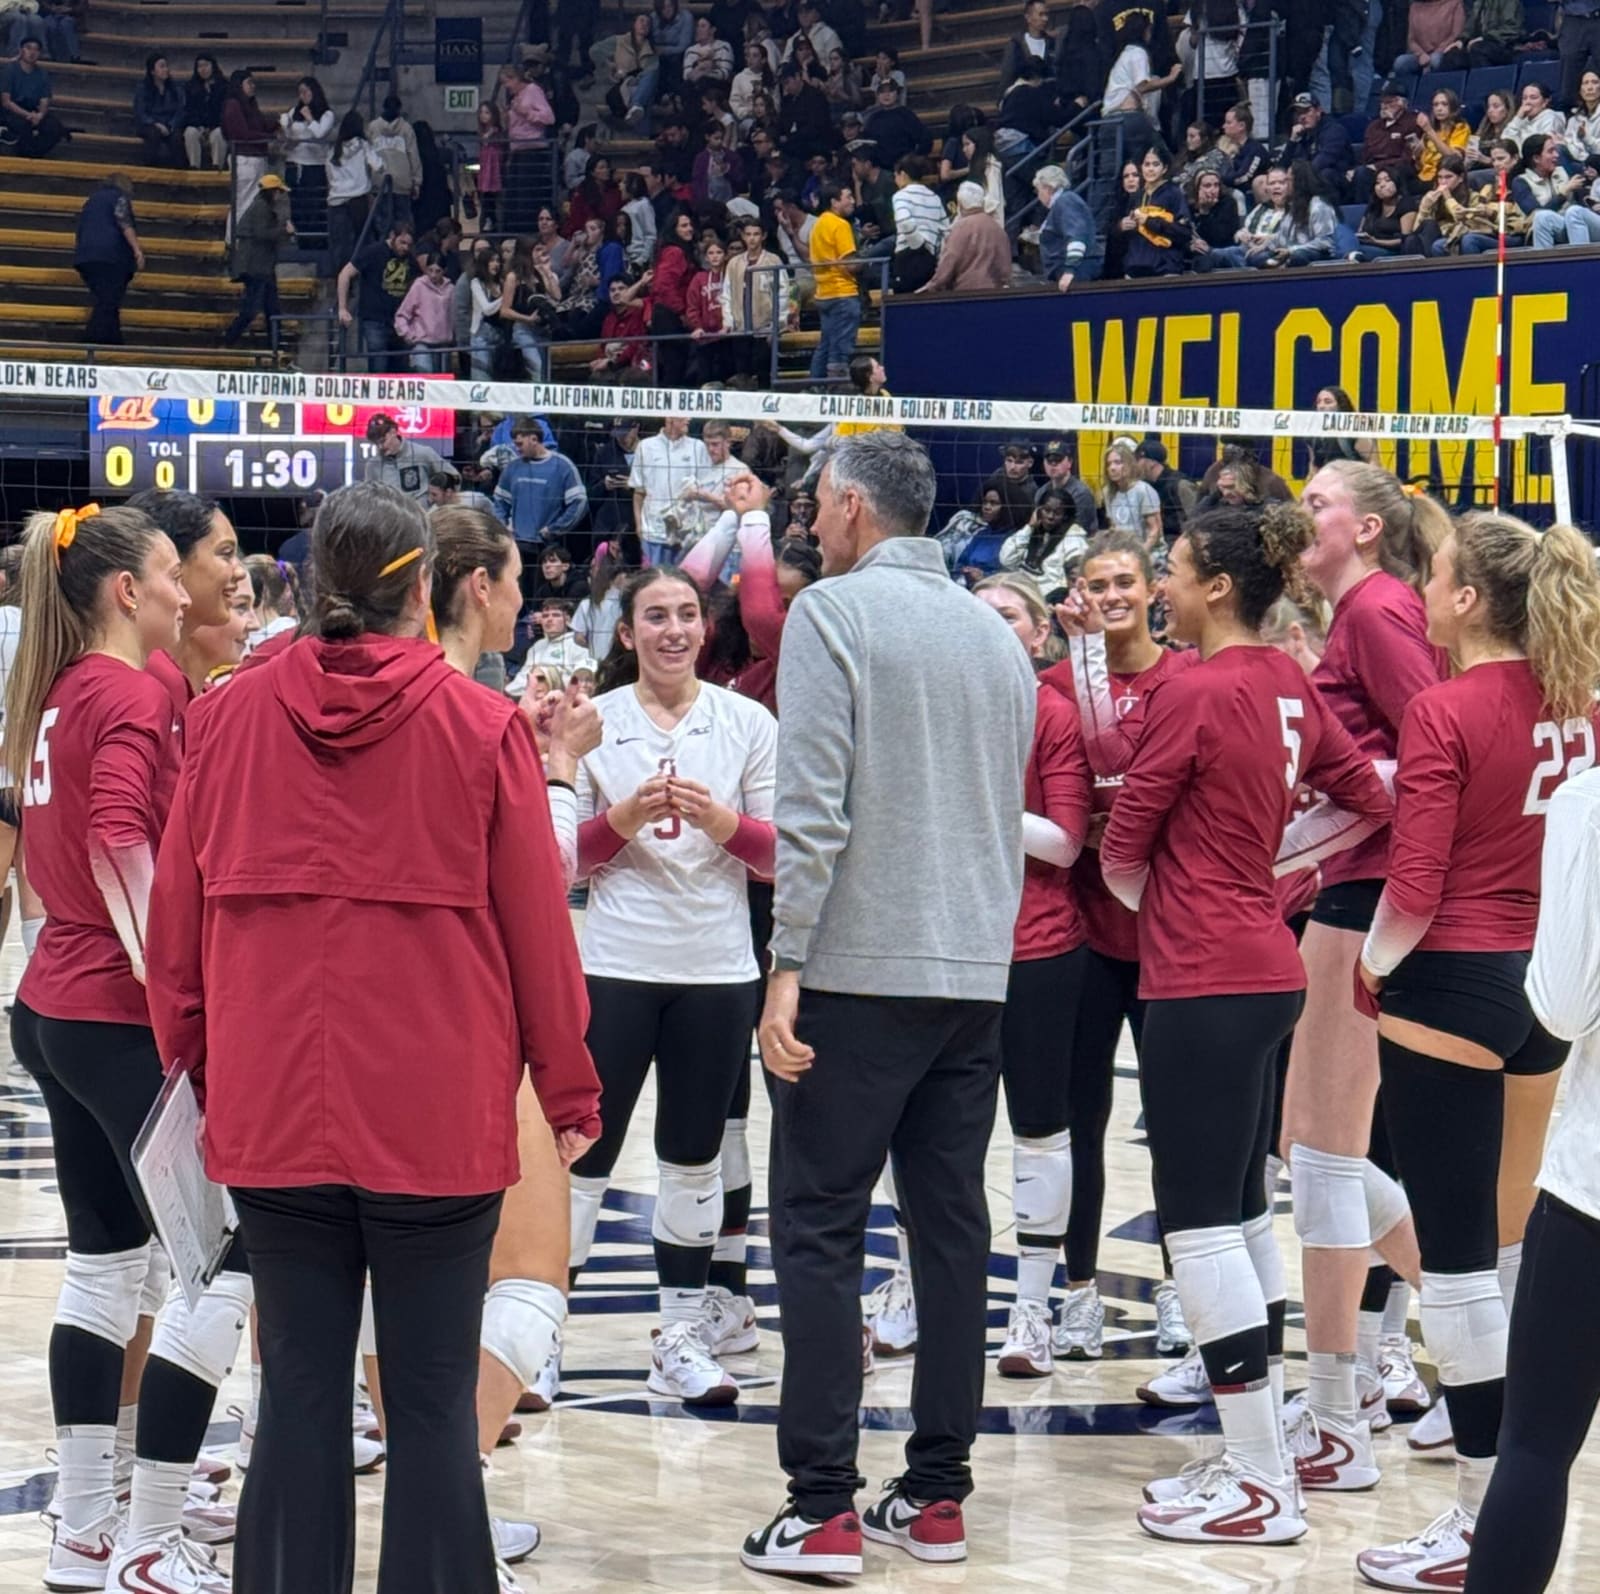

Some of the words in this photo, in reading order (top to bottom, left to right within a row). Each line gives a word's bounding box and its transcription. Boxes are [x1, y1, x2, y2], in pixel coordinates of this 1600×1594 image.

[440, 44, 479, 56] HAAS
[449, 90, 475, 108] EXIT
[0, 364, 36, 387] DEN
[45, 366, 98, 389] BEARS
[147, 370, 170, 391] Cal
[216, 373, 307, 397] CALIFORNIA
[314, 376, 371, 399] GOLDEN
[377, 379, 426, 401] BEARS
[470, 383, 491, 403] Cal
[533, 385, 615, 409] CALIFORNIA
[621, 389, 672, 410] GOLDEN
[678, 392, 723, 412] BEARS
[761, 395, 782, 413] Cal
[1071, 292, 1568, 505] WELCOME
[260, 402, 281, 429] 4
[819, 396, 894, 418] CALIFORNIA
[900, 399, 947, 420] GOLDEN
[952, 401, 993, 421] BEARS
[1028, 404, 1048, 422] Cal
[1081, 405, 1150, 425] CALIFORNIA
[1155, 409, 1199, 427] GOLDEN
[1203, 410, 1241, 429] BEARS
[1274, 412, 1291, 430] Cal
[1322, 413, 1386, 432] CALIFORNIA
[1390, 415, 1430, 434] GOLDEN
[1434, 416, 1469, 434] BEARS
[148, 441, 182, 457] TOL
[106, 446, 133, 487] 0
[156, 460, 175, 491] 0
[225, 448, 317, 488] 1:30
[1276, 697, 1304, 790] 5
[1521, 715, 1596, 816] 22
